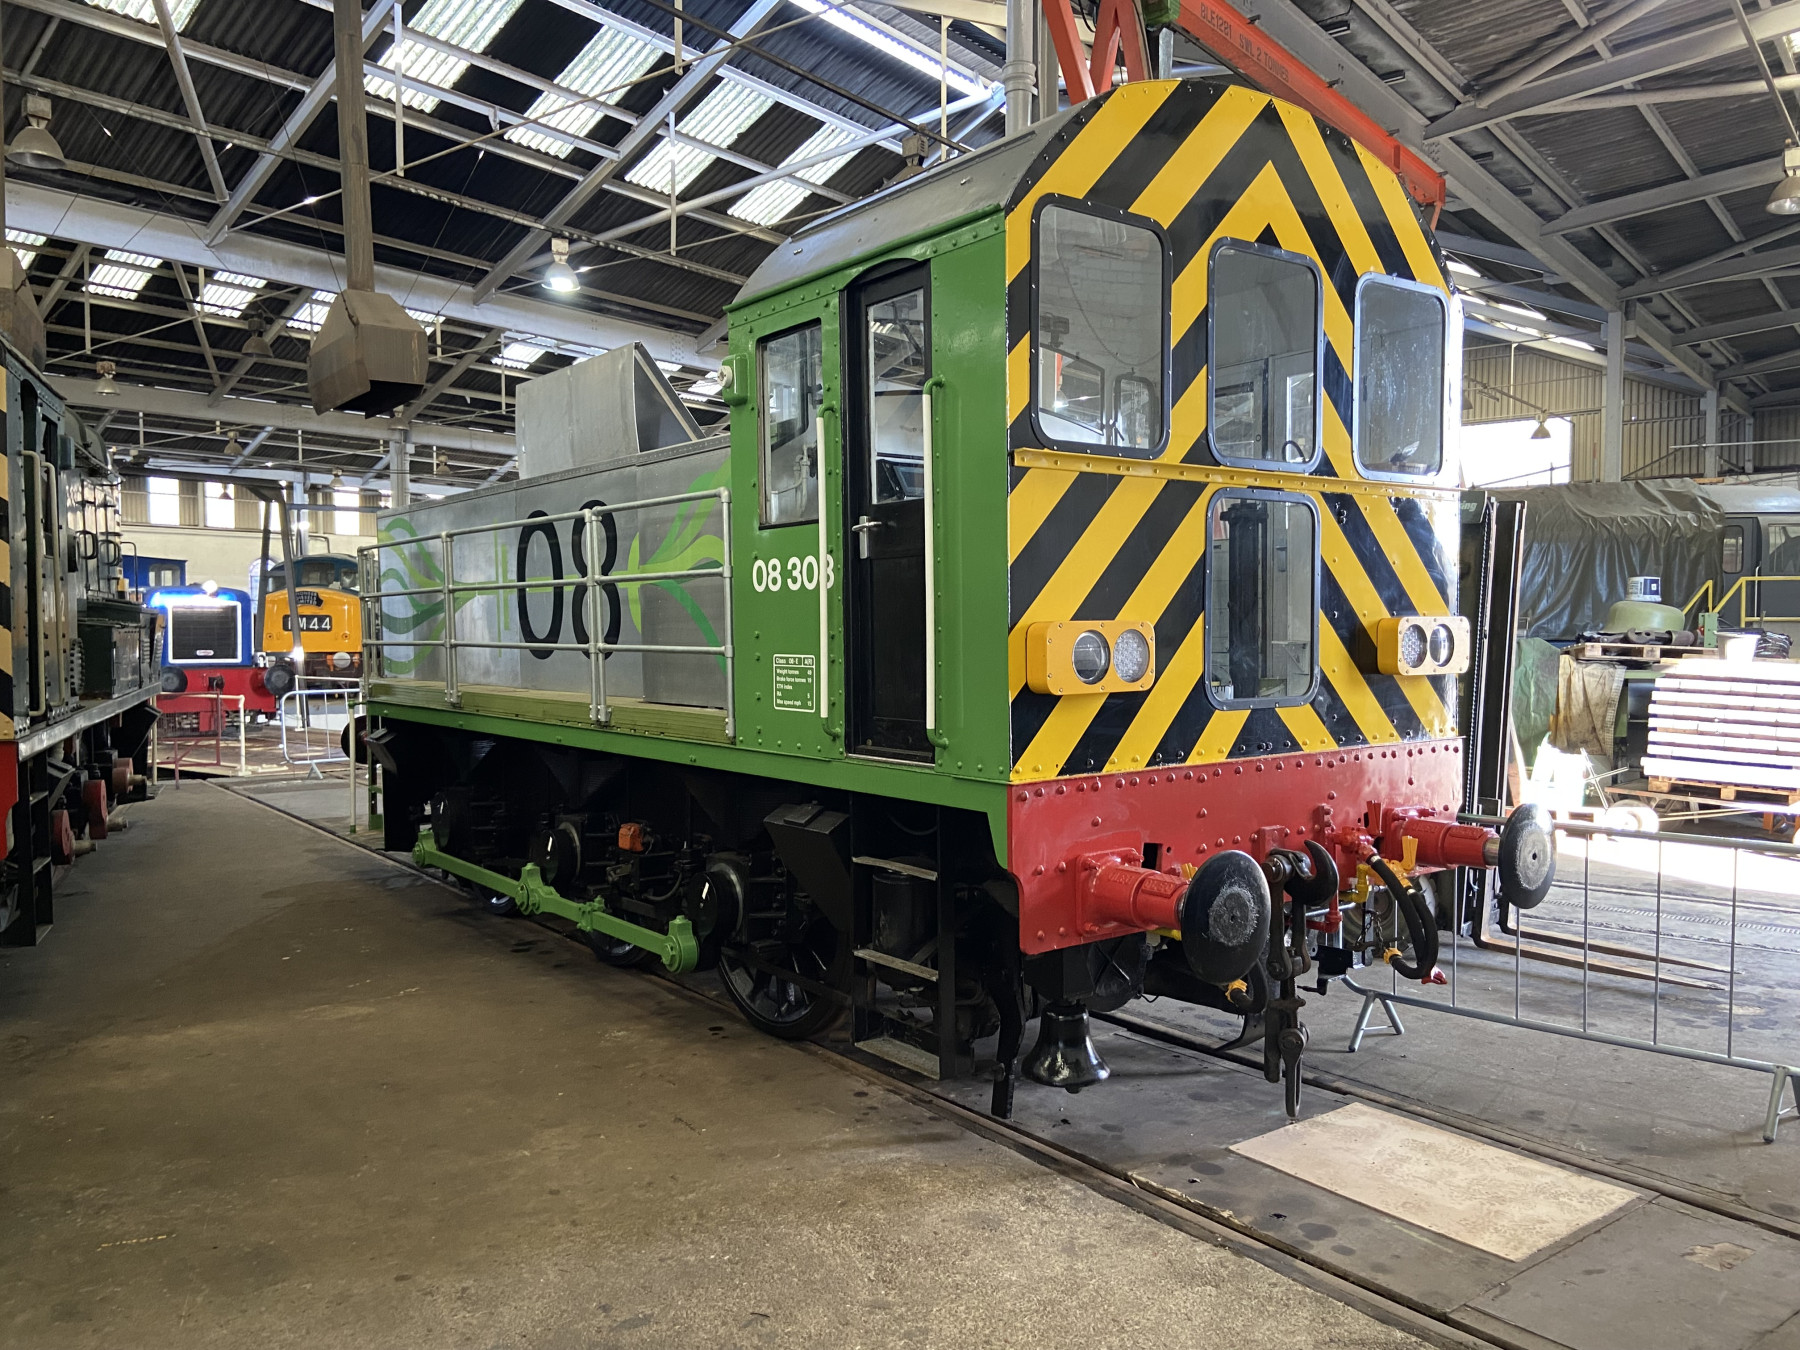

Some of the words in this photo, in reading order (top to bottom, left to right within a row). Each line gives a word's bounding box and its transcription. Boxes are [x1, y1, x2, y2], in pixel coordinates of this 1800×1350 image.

[1256, 47, 1262, 60] 2
[516, 499, 622, 660] 08
[752, 559, 782, 593] 08
[786, 553, 835, 591] 308
